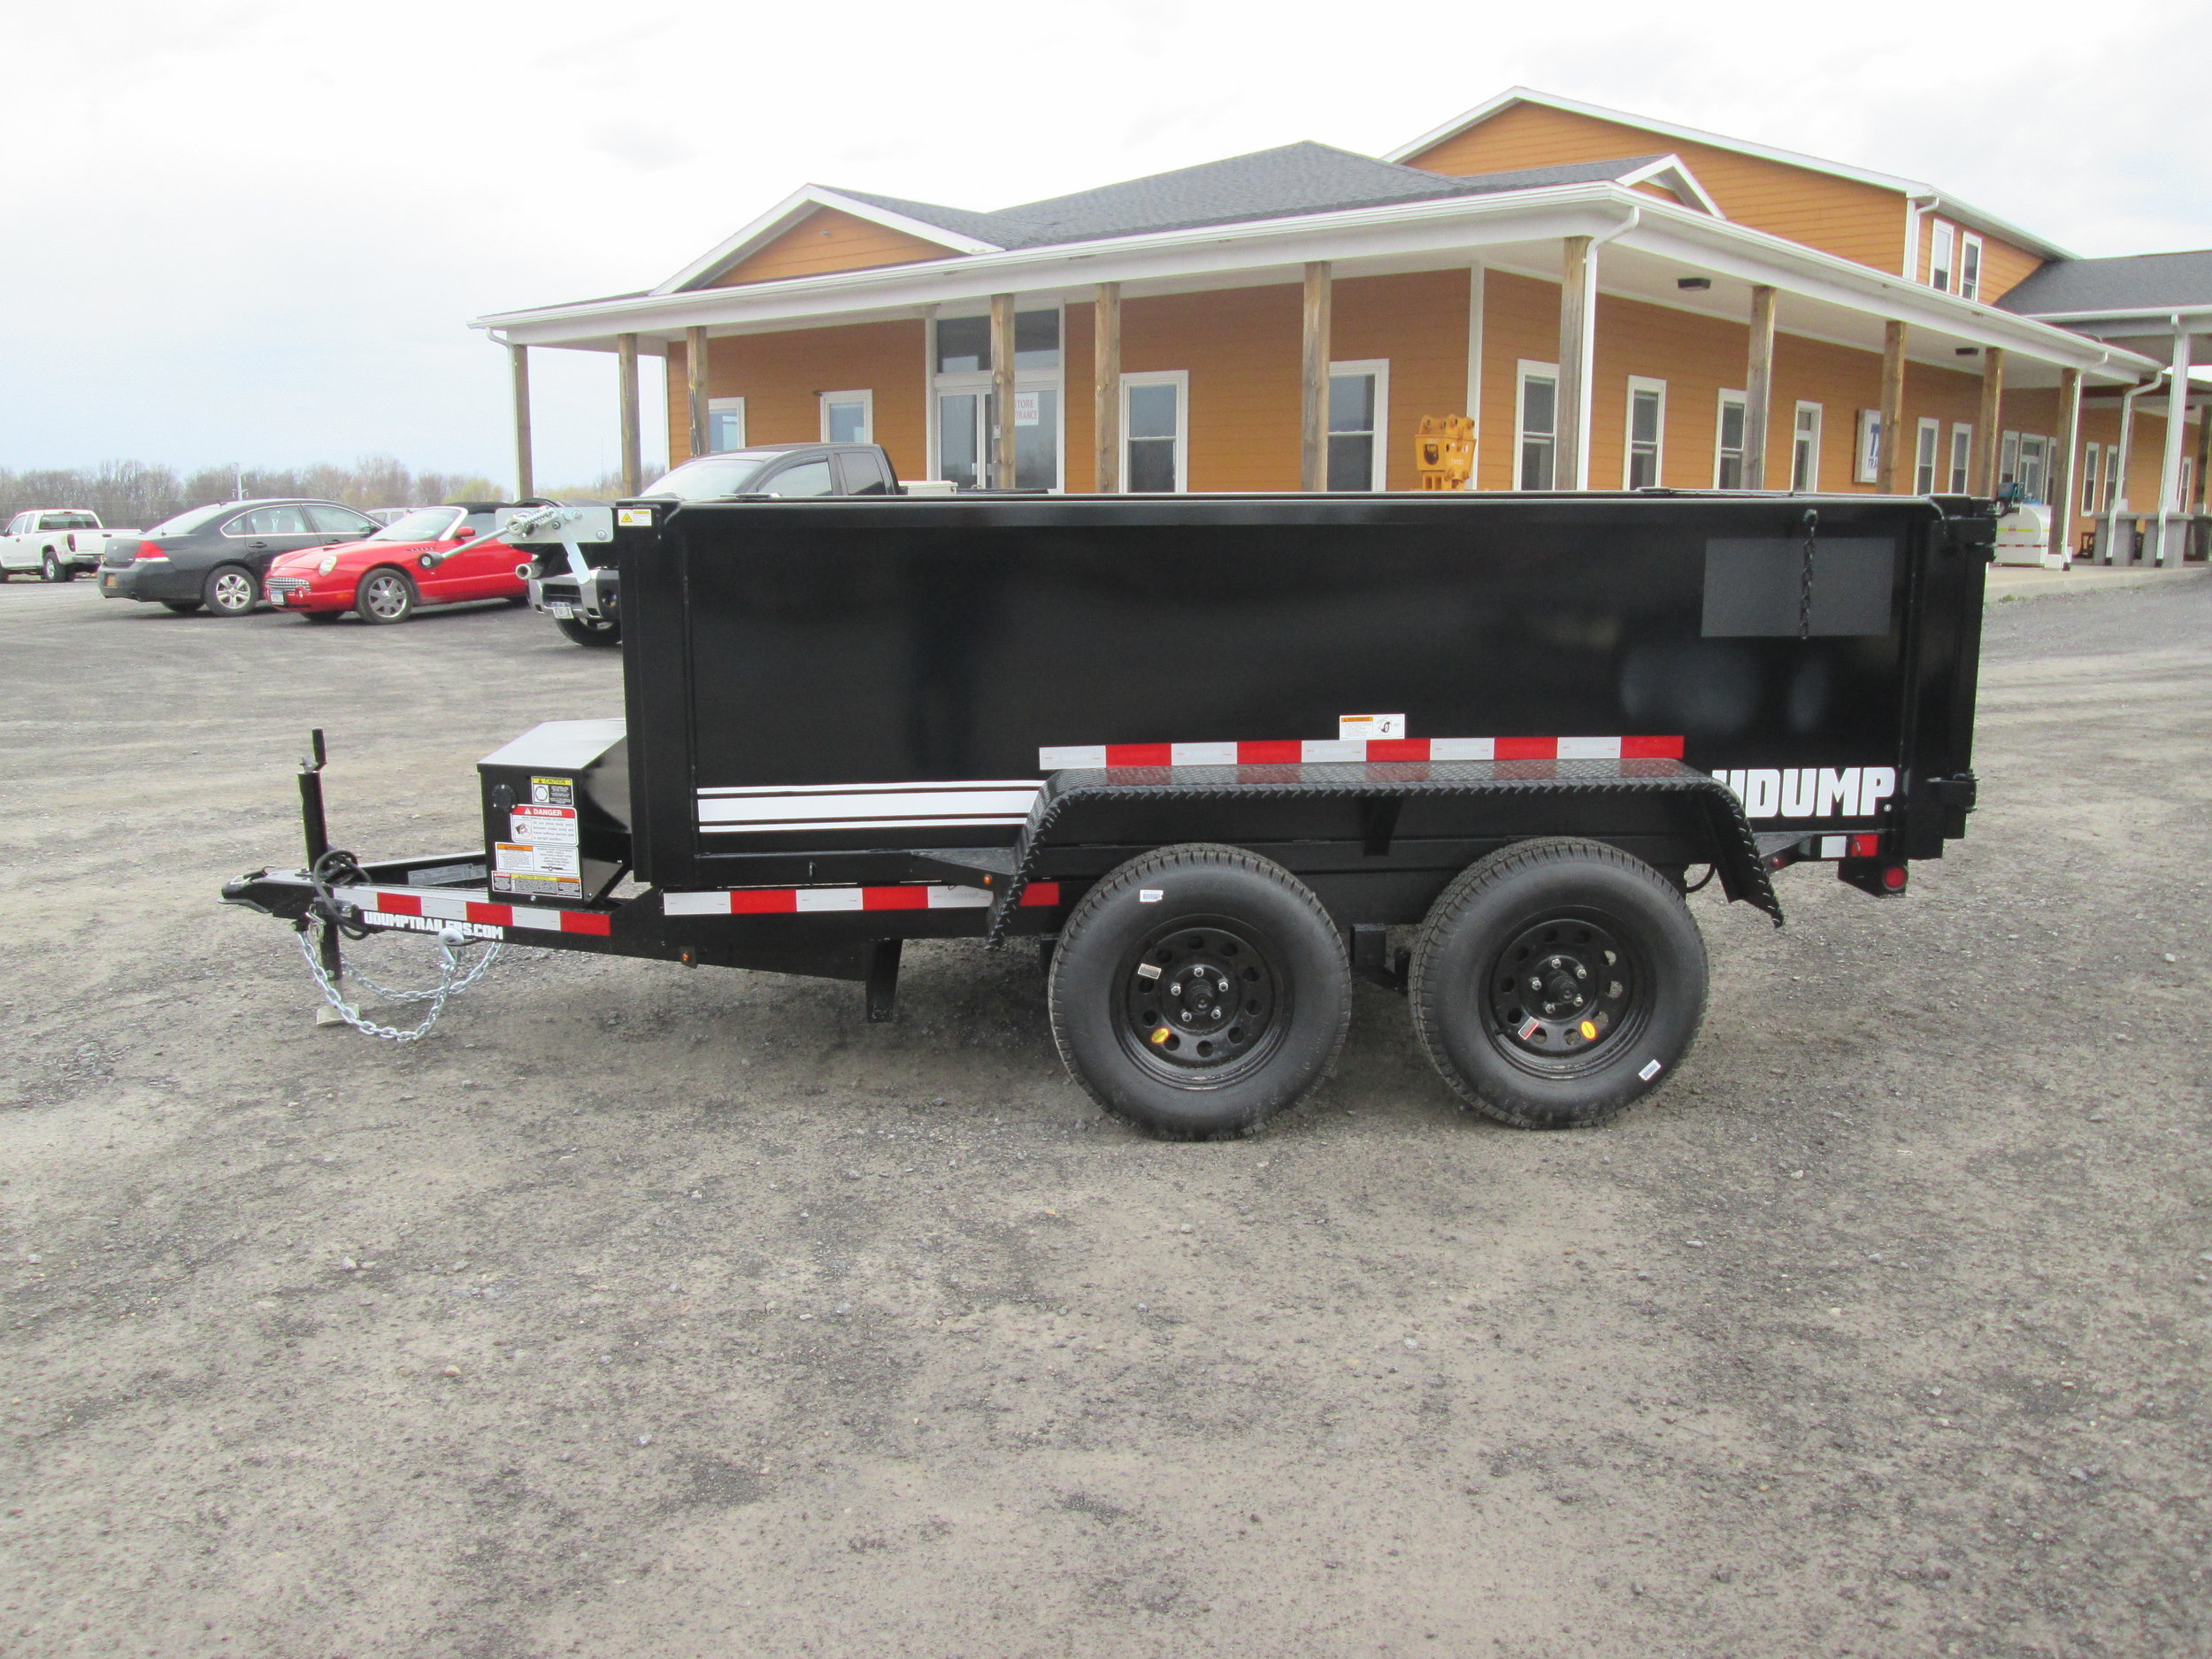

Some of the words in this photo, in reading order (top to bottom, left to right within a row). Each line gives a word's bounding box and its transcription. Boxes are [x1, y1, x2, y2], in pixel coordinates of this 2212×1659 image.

[1015, 399, 1033, 409] TORE
[1015, 410, 1038, 420] TRANCE
[533, 808, 563, 817] DANGER
